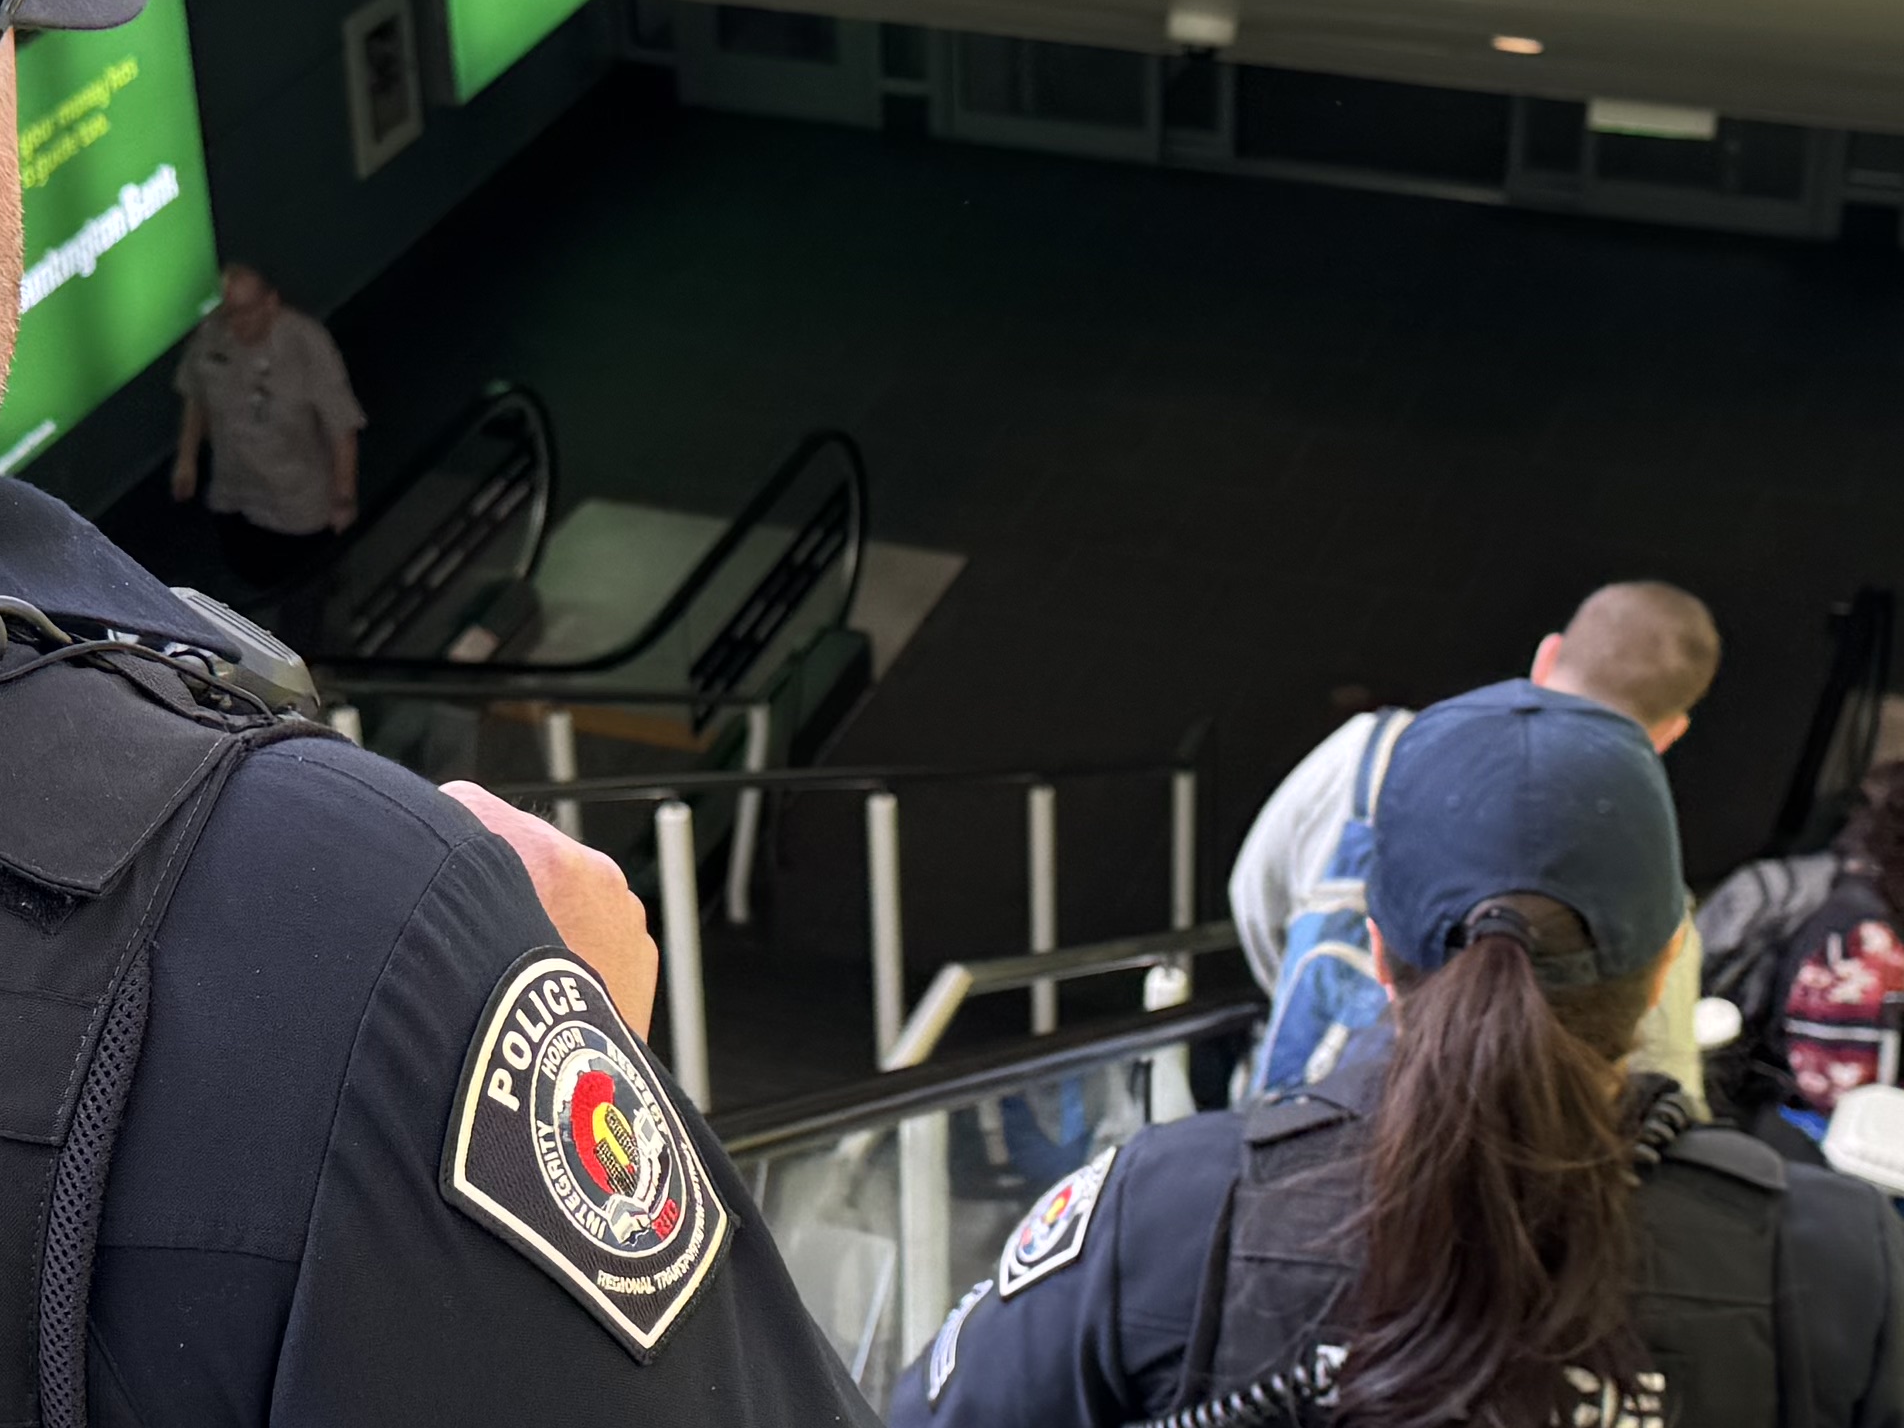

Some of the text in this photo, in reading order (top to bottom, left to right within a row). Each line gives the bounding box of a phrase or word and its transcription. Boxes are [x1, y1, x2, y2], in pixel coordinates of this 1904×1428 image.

[19, 205, 128, 314] untington
[488, 975, 589, 1111] POLICE
[540, 1027, 586, 1081] HONOR
[536, 1119, 607, 1240] INTEGRITY
[597, 1269, 656, 1295] REGIONAL
